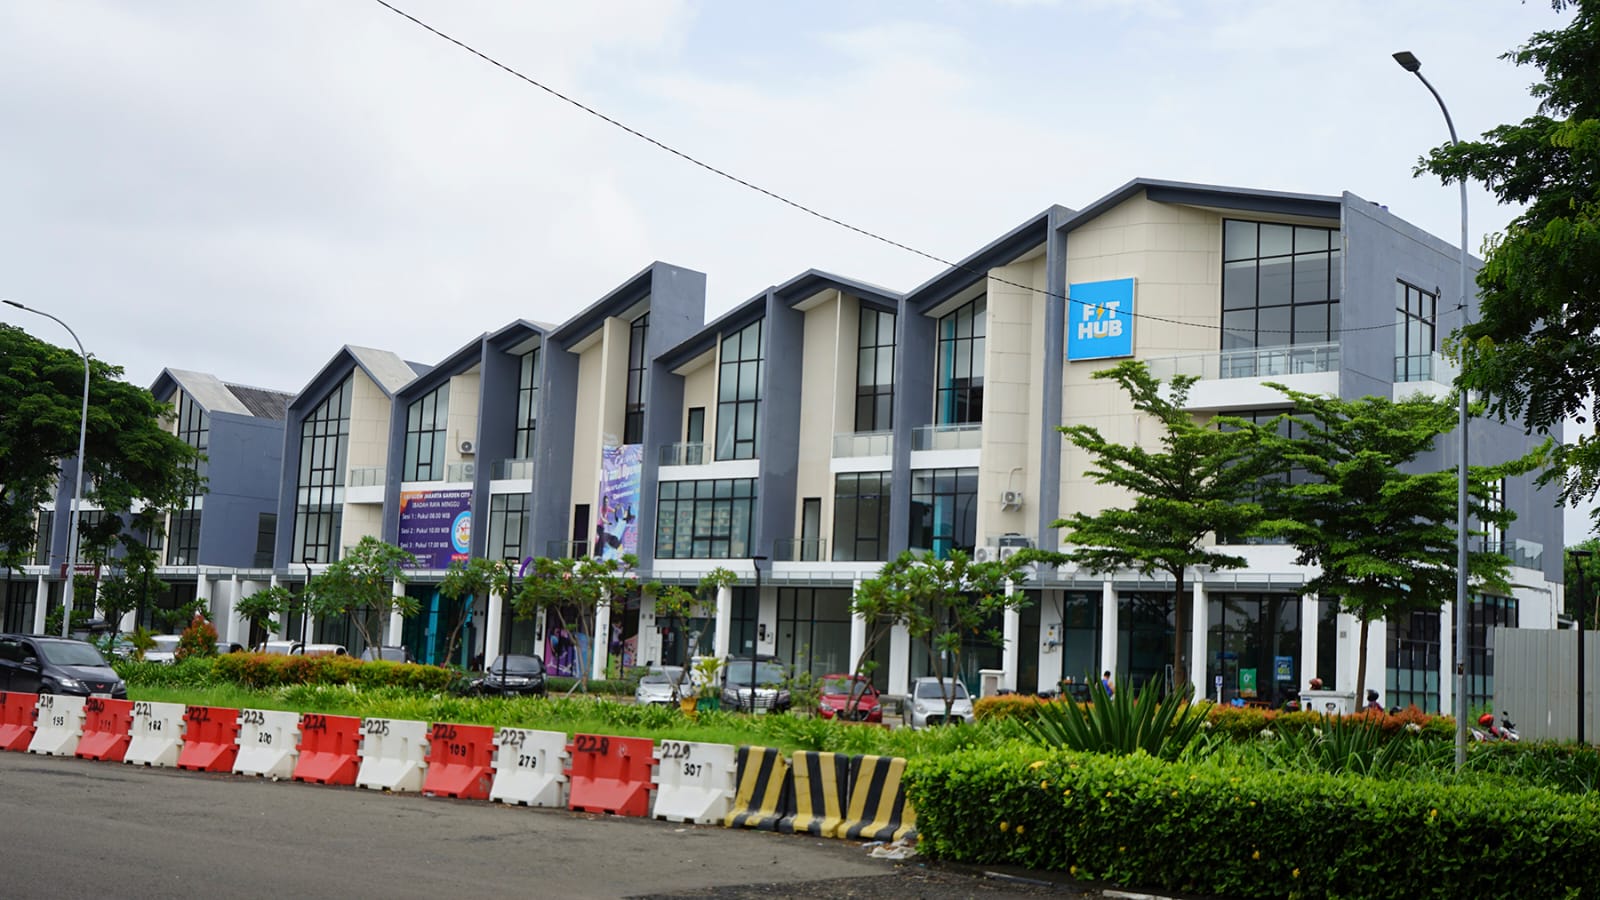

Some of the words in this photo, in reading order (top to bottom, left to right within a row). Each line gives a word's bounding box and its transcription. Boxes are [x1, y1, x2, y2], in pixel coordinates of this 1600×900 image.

[1083, 301, 1120, 321] FIT
[1078, 320, 1122, 340] HUB
[136, 703, 152, 717] 221
[188, 707, 211, 722] 222
[244, 710, 265, 725] 223
[366, 719, 390, 736] 225
[433, 723, 457, 740] 226
[258, 732, 272, 744] 200
[501, 729, 526, 748] 227
[576, 735, 610, 756] 228
[662, 742, 691, 759] 229
[518, 755, 537, 768] 279
[684, 763, 702, 777] 307
